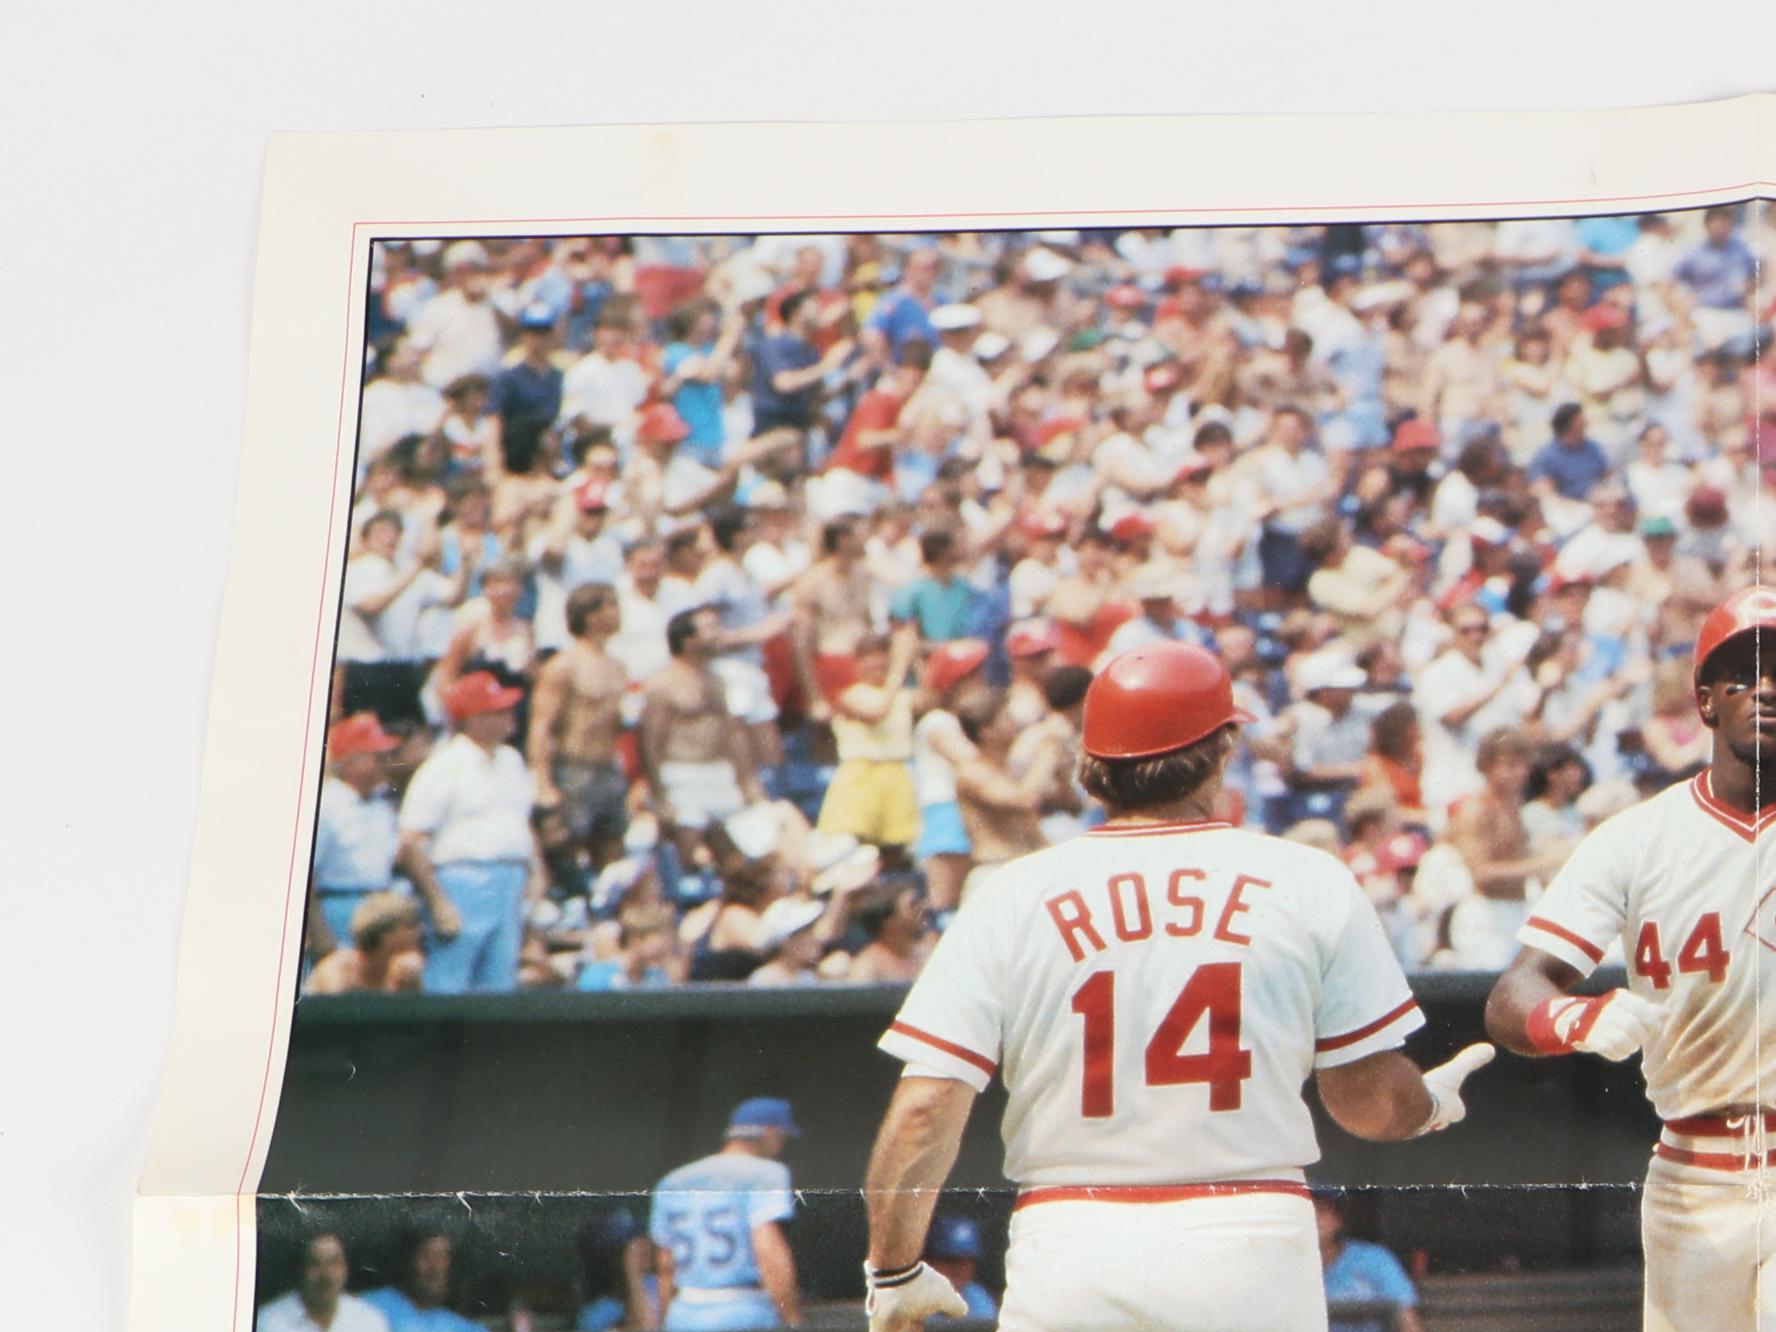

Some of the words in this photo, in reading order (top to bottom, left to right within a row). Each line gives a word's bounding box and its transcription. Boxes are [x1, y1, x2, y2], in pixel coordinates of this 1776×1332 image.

[1044, 868, 1273, 963] ROSE
[1634, 911, 1731, 990] 44
[1071, 961, 1252, 1118] 14
[664, 1205, 737, 1267] 55
